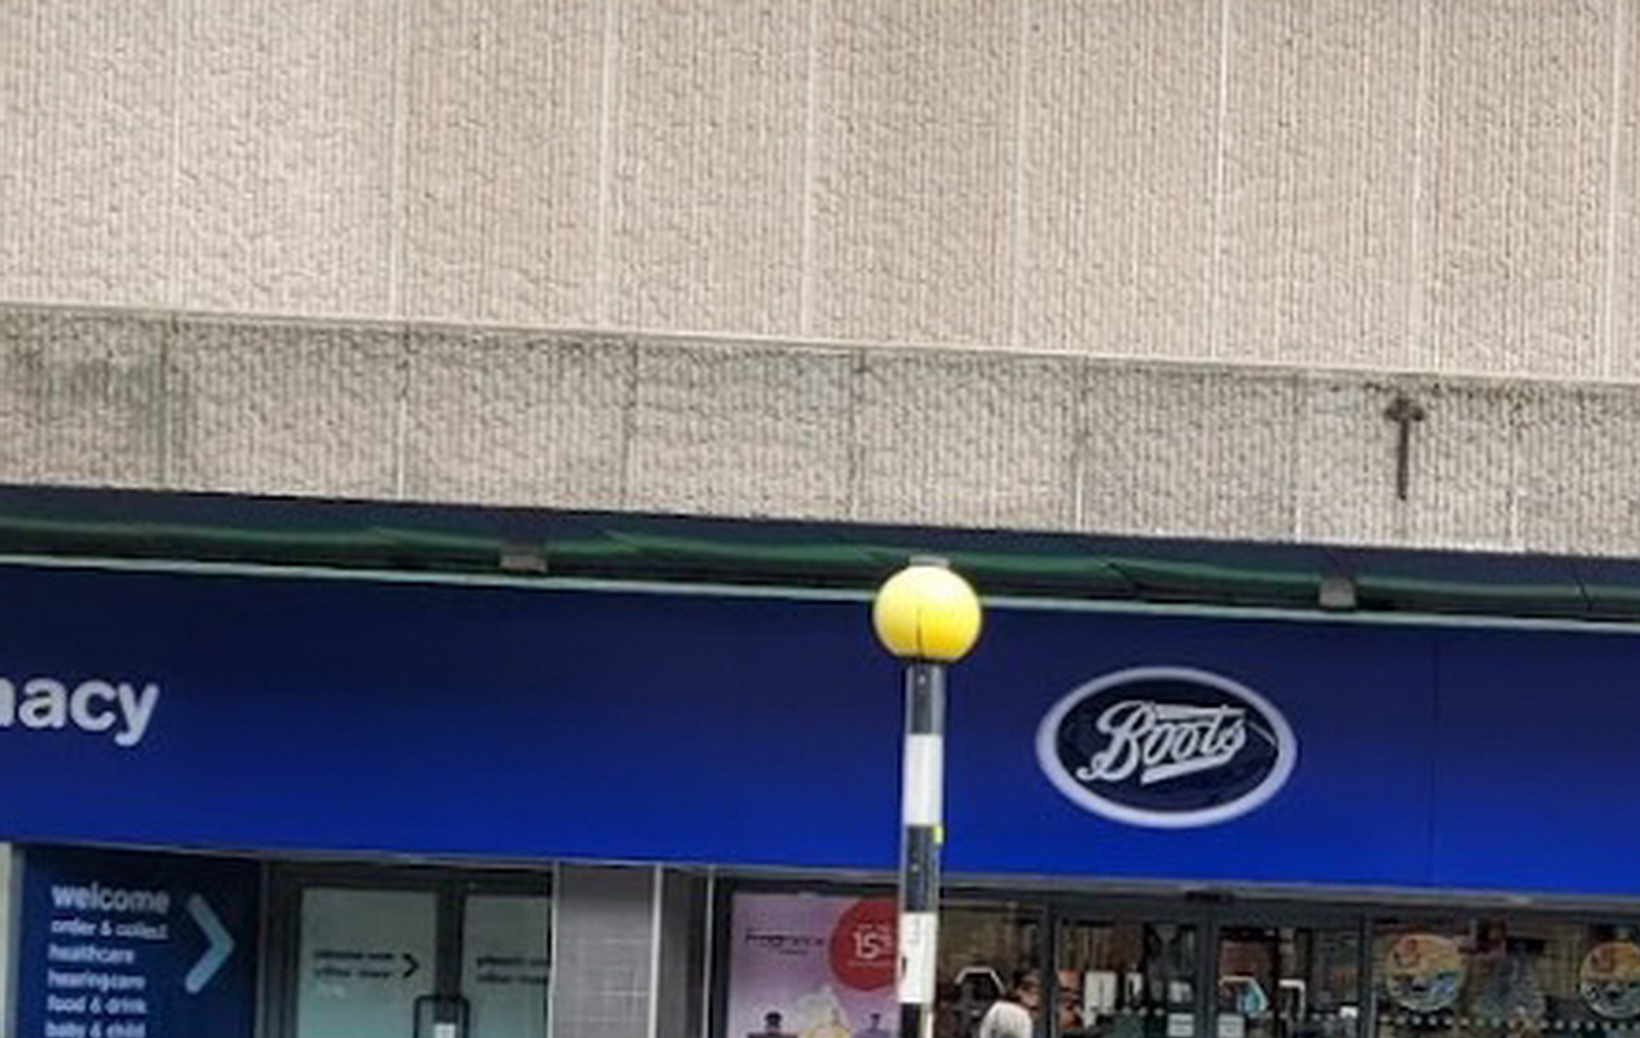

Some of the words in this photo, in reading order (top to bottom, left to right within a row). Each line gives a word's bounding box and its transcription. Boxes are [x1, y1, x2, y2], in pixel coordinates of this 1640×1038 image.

[0, 676, 160, 747] acy
[1075, 699, 1247, 786] Boots
[51, 881, 170, 914] welcome
[51, 917, 96, 937] order
[101, 920, 112, 937] &
[115, 922, 170, 940] collect
[48, 944, 135, 964] healthcare
[48, 968, 146, 993] hearingcare
[47, 994, 86, 1013] food
[89, 996, 101, 1014] &
[104, 996, 147, 1015] drink
